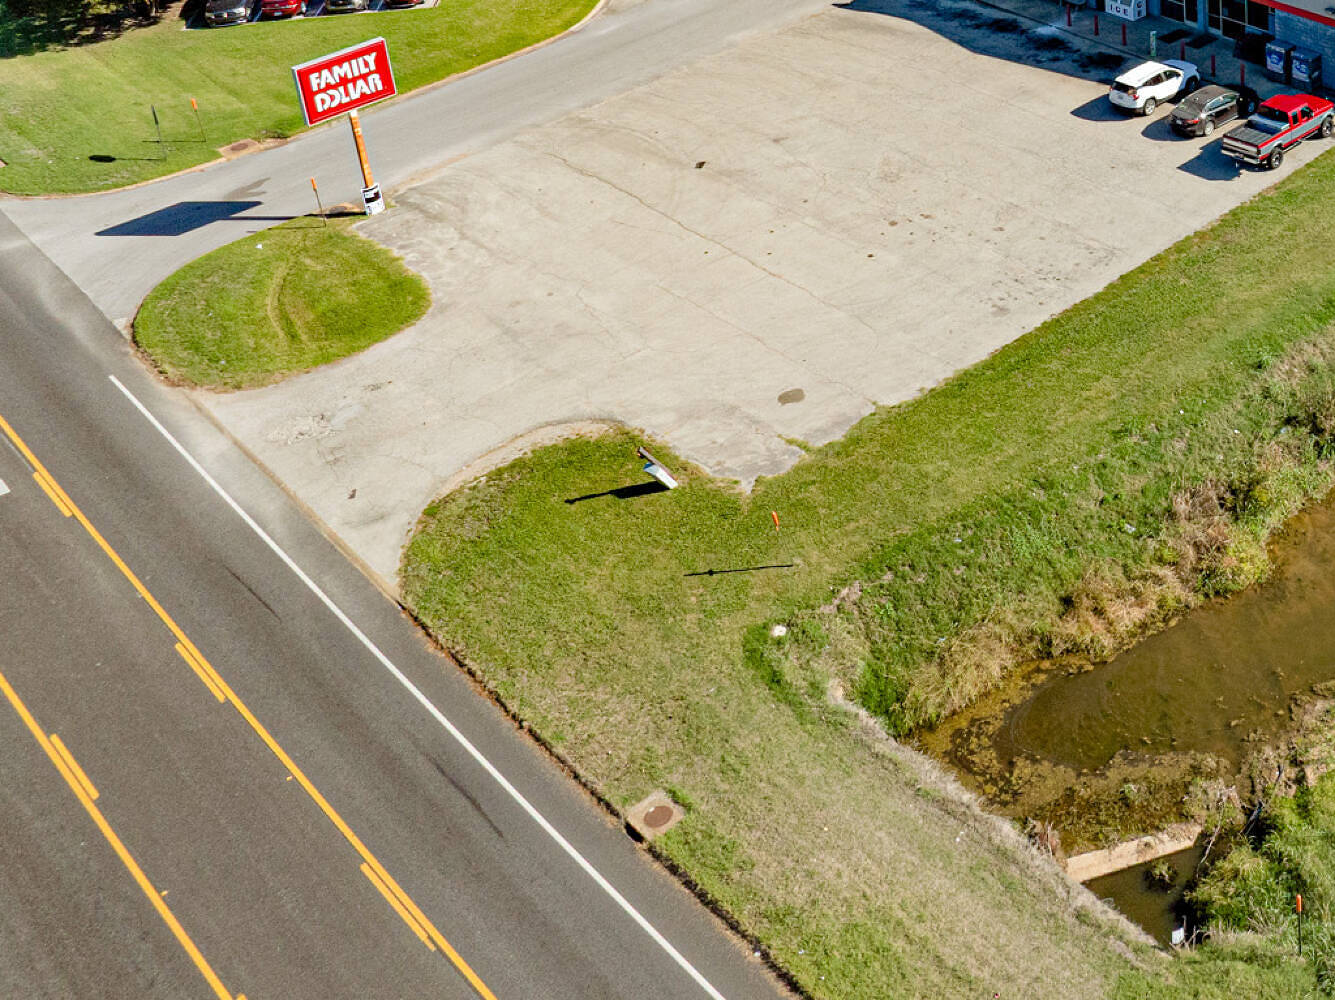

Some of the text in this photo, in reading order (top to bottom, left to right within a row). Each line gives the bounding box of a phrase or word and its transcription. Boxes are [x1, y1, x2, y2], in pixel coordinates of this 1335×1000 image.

[1110, 3, 1129, 17] ICE
[308, 51, 377, 92] FAMILY
[313, 72, 384, 113] DOLLAR
